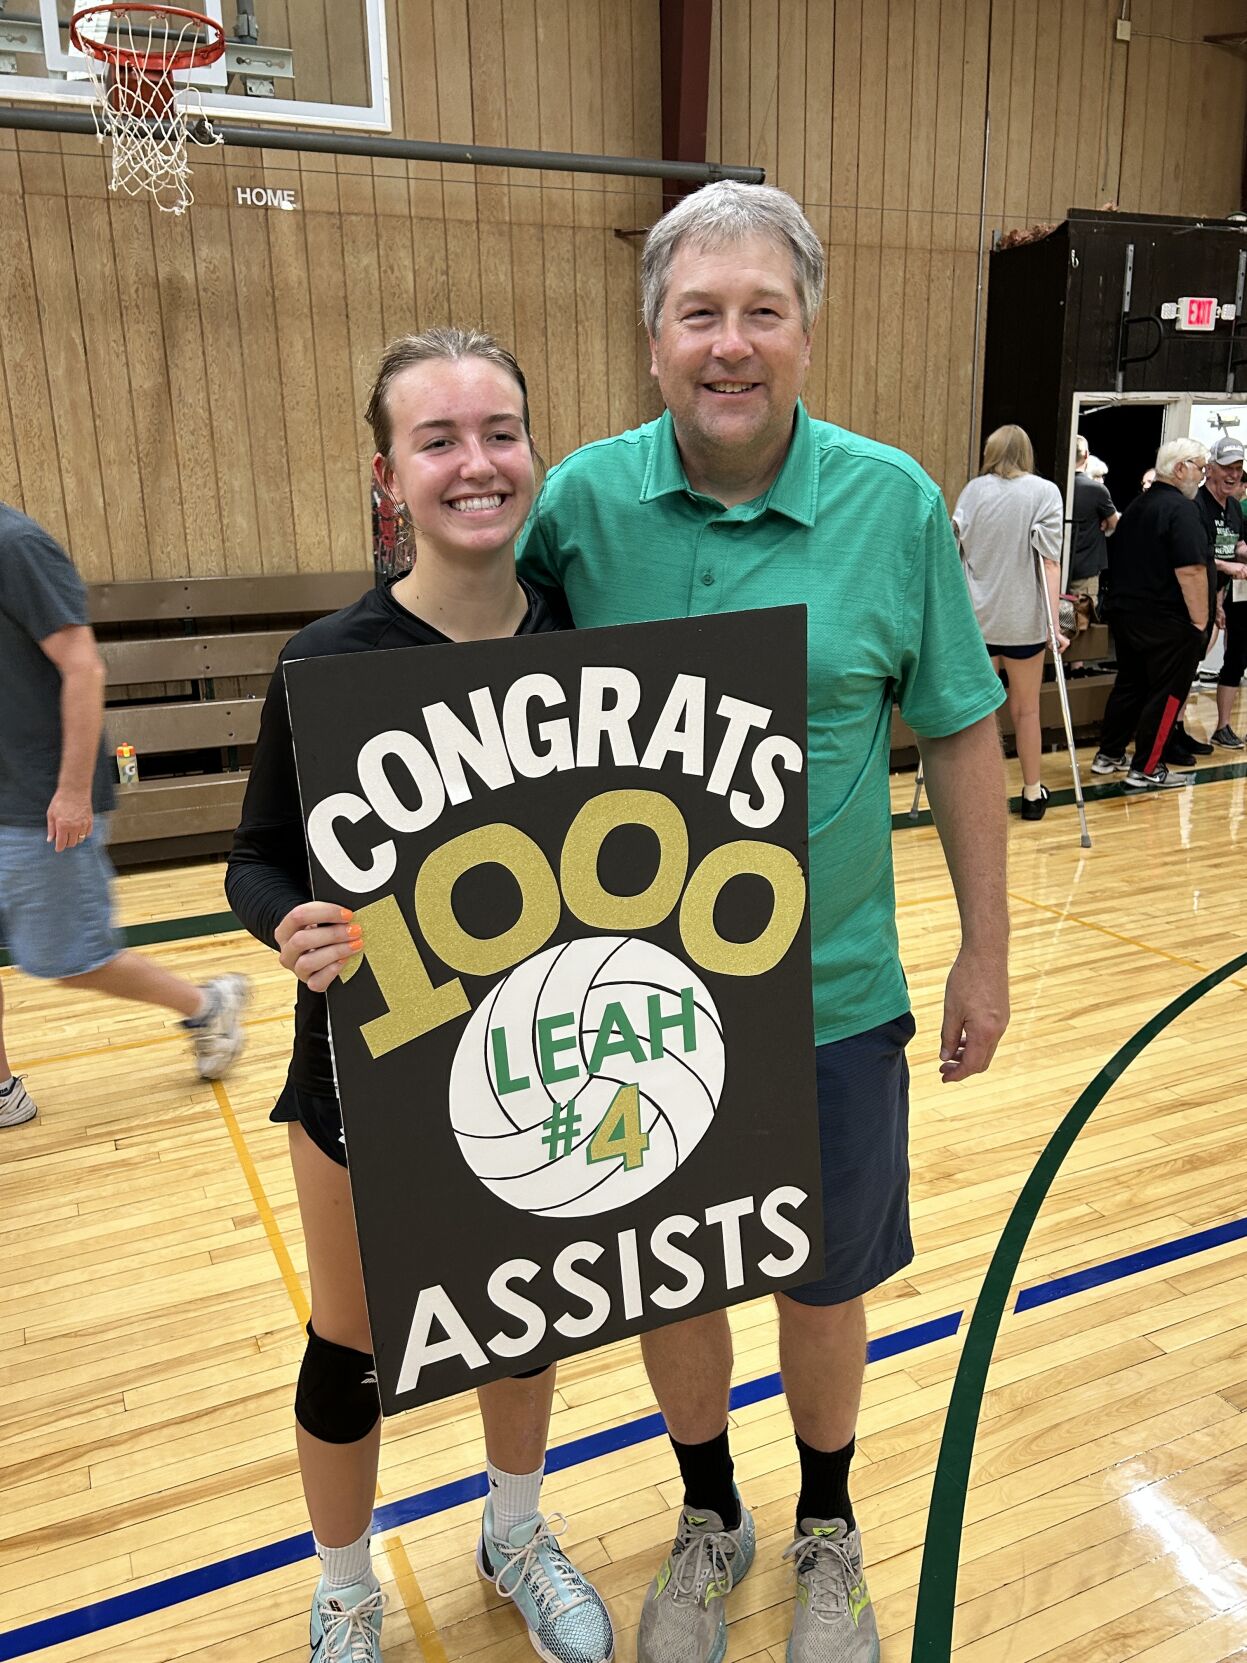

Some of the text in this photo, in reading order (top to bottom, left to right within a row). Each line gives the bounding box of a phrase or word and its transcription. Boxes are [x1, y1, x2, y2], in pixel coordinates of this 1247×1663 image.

[237, 187, 296, 209] HOME
[1187, 299, 1213, 325] EXIT
[307, 666, 803, 893] CONGRATS
[339, 789, 806, 1059] 1000
[491, 986, 697, 1096] LEAH
[541, 1082, 650, 1172] #4
[395, 1185, 811, 1396] ASSISTS
